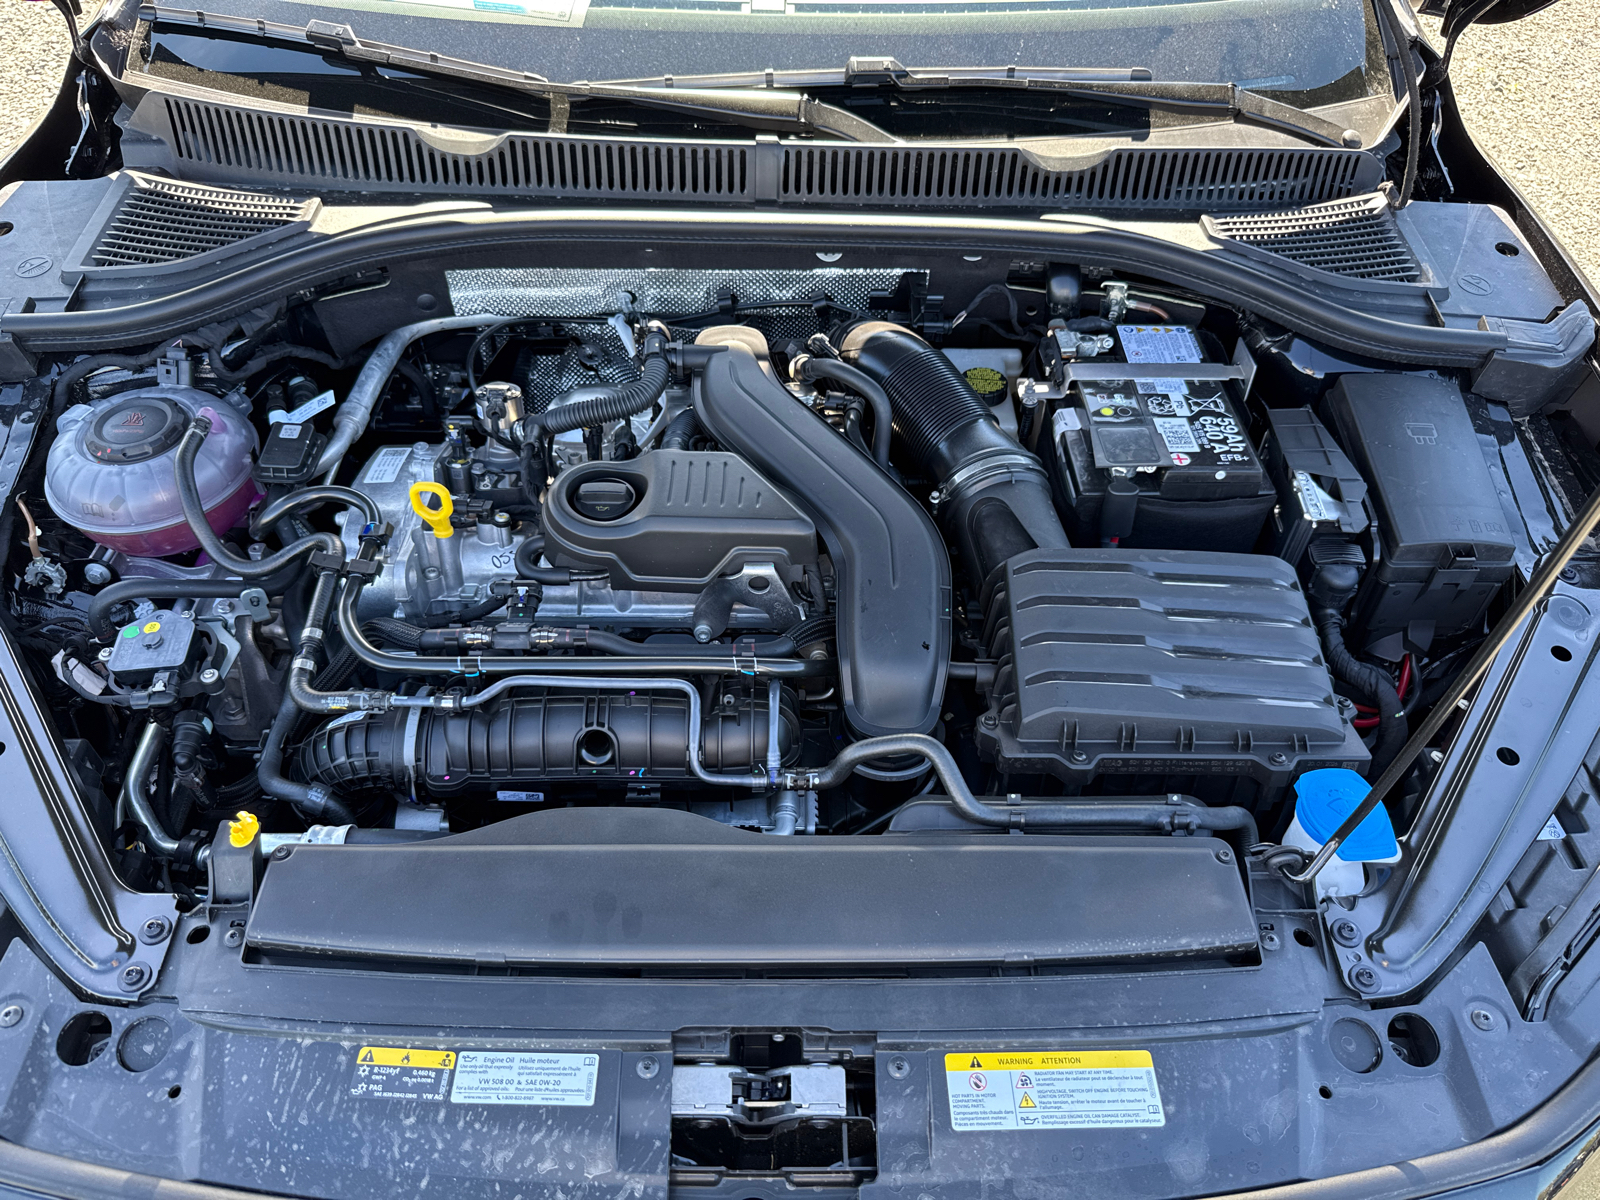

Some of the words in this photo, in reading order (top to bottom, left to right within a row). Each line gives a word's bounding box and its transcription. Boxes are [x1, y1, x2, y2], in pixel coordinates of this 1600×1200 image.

[1174, 400, 1184, 409] Pb
[1199, 416, 1224, 440] 640
[1217, 417, 1246, 452] 59Ah
[1210, 442, 1230, 453] A
[1041, 1057, 1081, 1065] ATTENTION
